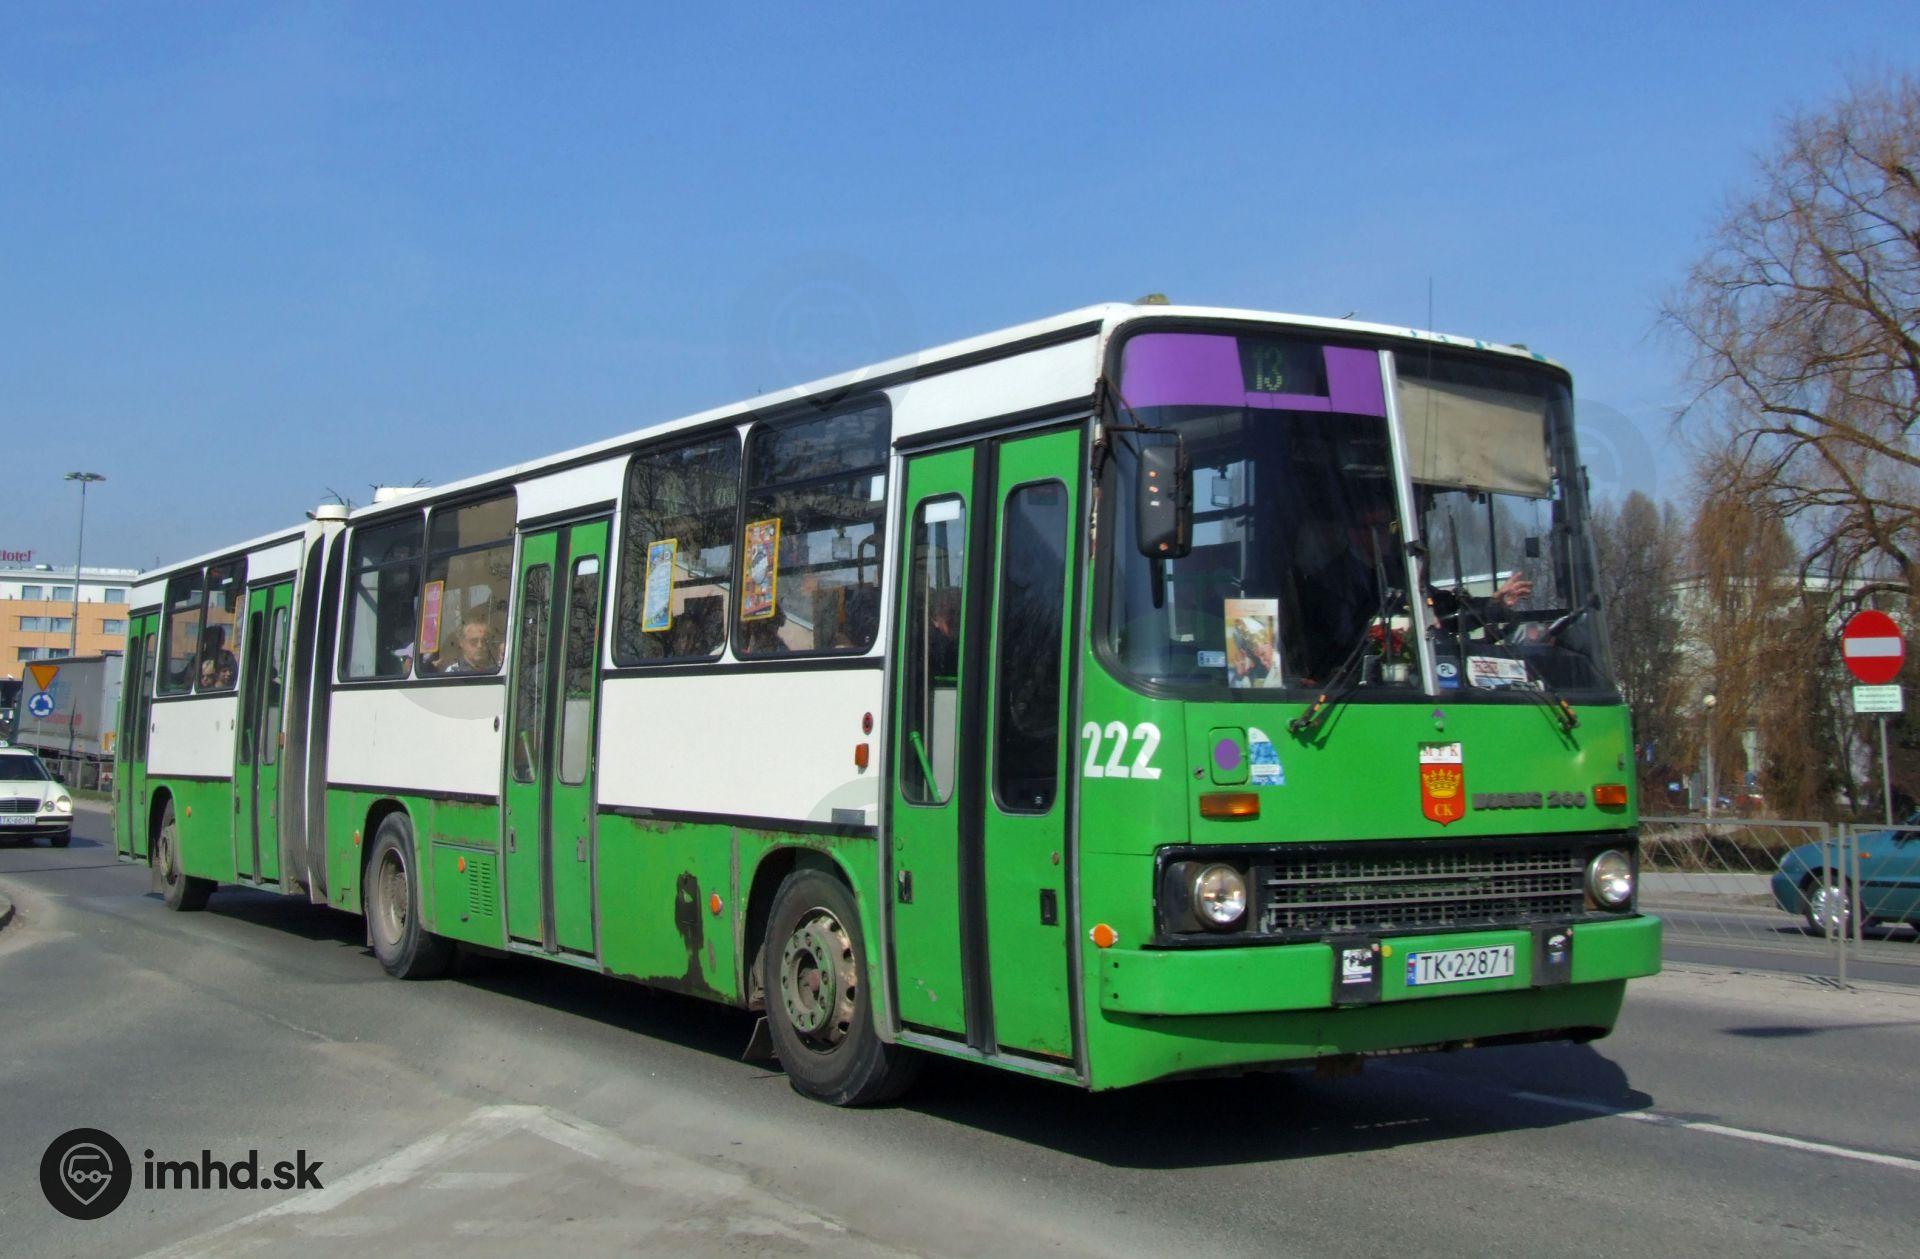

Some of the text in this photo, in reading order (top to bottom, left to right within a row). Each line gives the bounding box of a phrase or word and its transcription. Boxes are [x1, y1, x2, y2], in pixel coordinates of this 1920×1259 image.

[1253, 346, 1283, 391] 13
[1440, 664, 1454, 675] PL
[1082, 721, 1162, 780] 222
[1433, 803, 1454, 817] CK
[1420, 955, 1447, 980] TK
[1454, 949, 1512, 977] 22871
